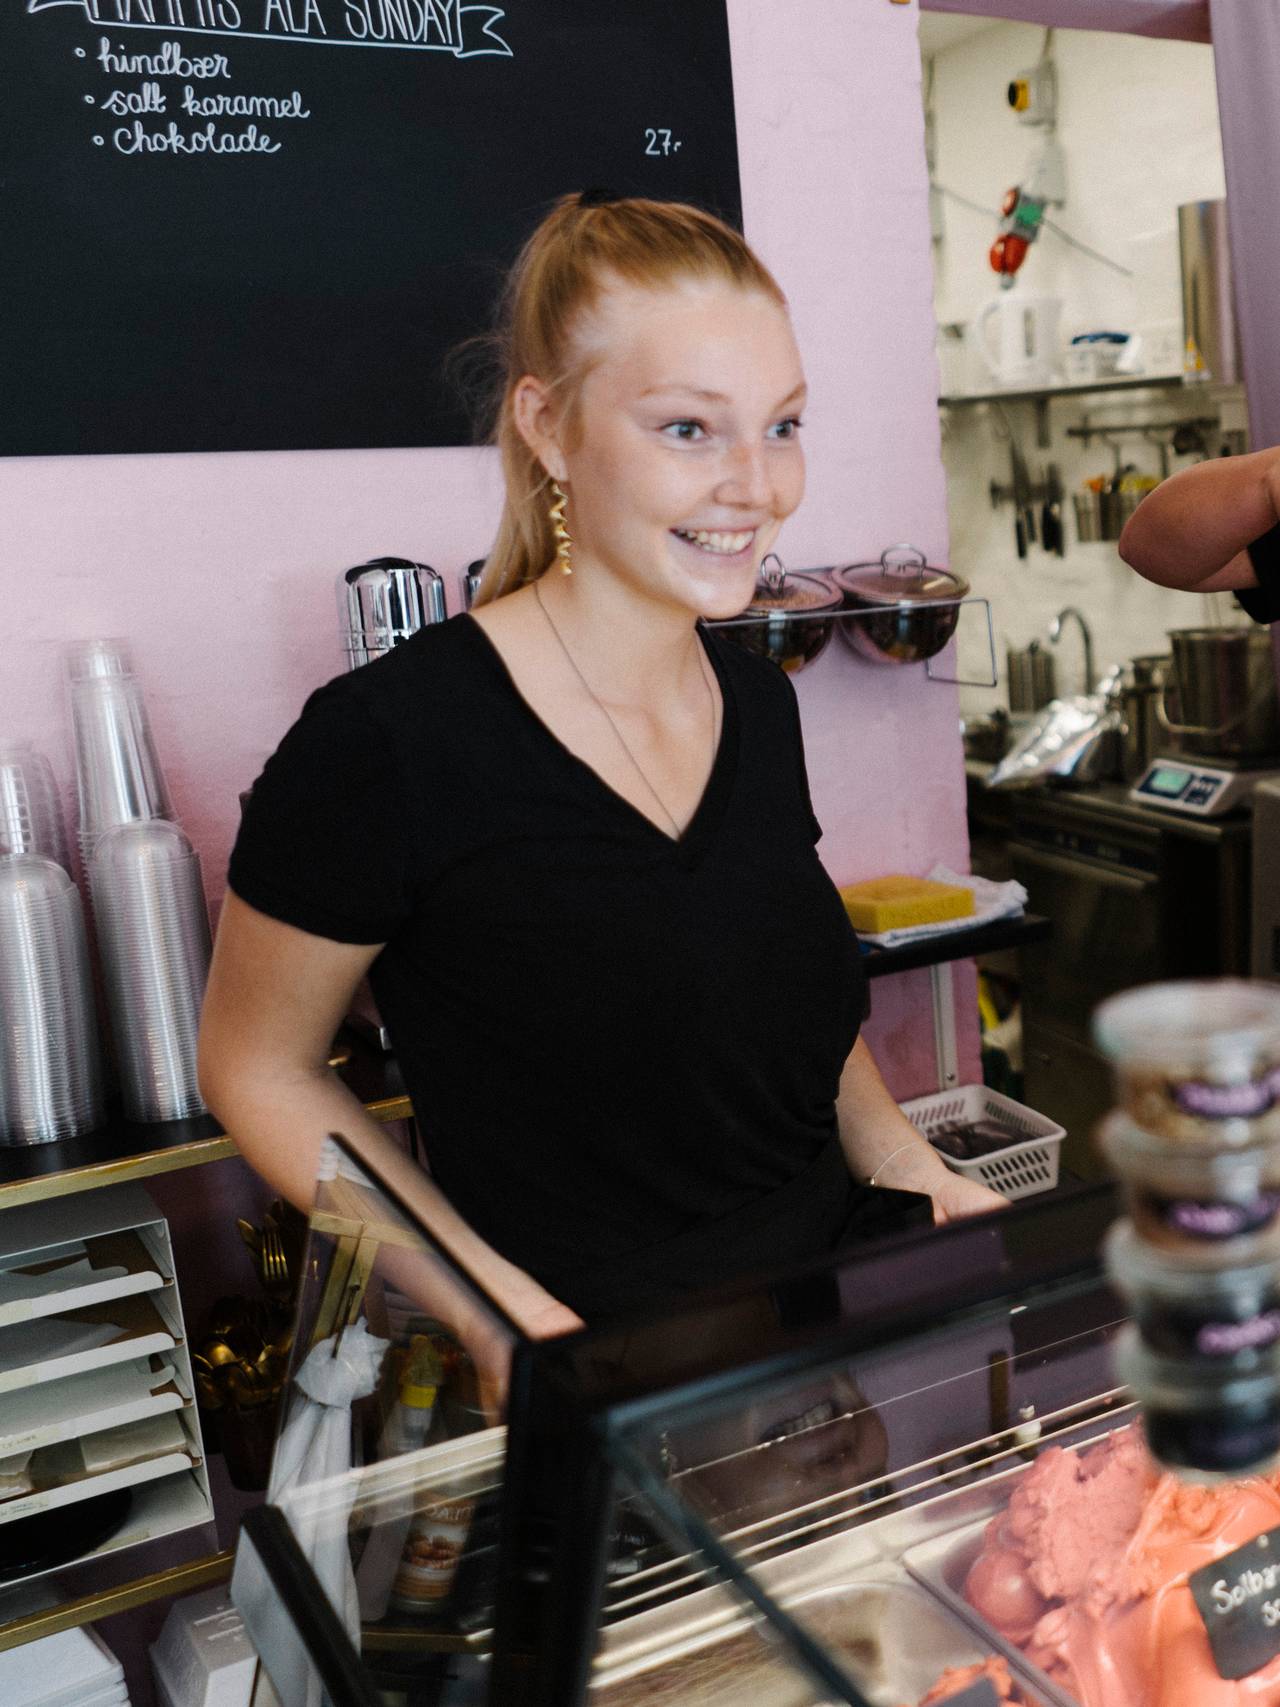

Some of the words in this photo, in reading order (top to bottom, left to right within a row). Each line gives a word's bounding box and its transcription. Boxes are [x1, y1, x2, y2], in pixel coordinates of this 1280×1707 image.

[345, 0, 453, 44] SUNDAY
[97, 36, 231, 79] hindbær
[101, 82, 167, 116] salt
[181, 85, 311, 118] karamel
